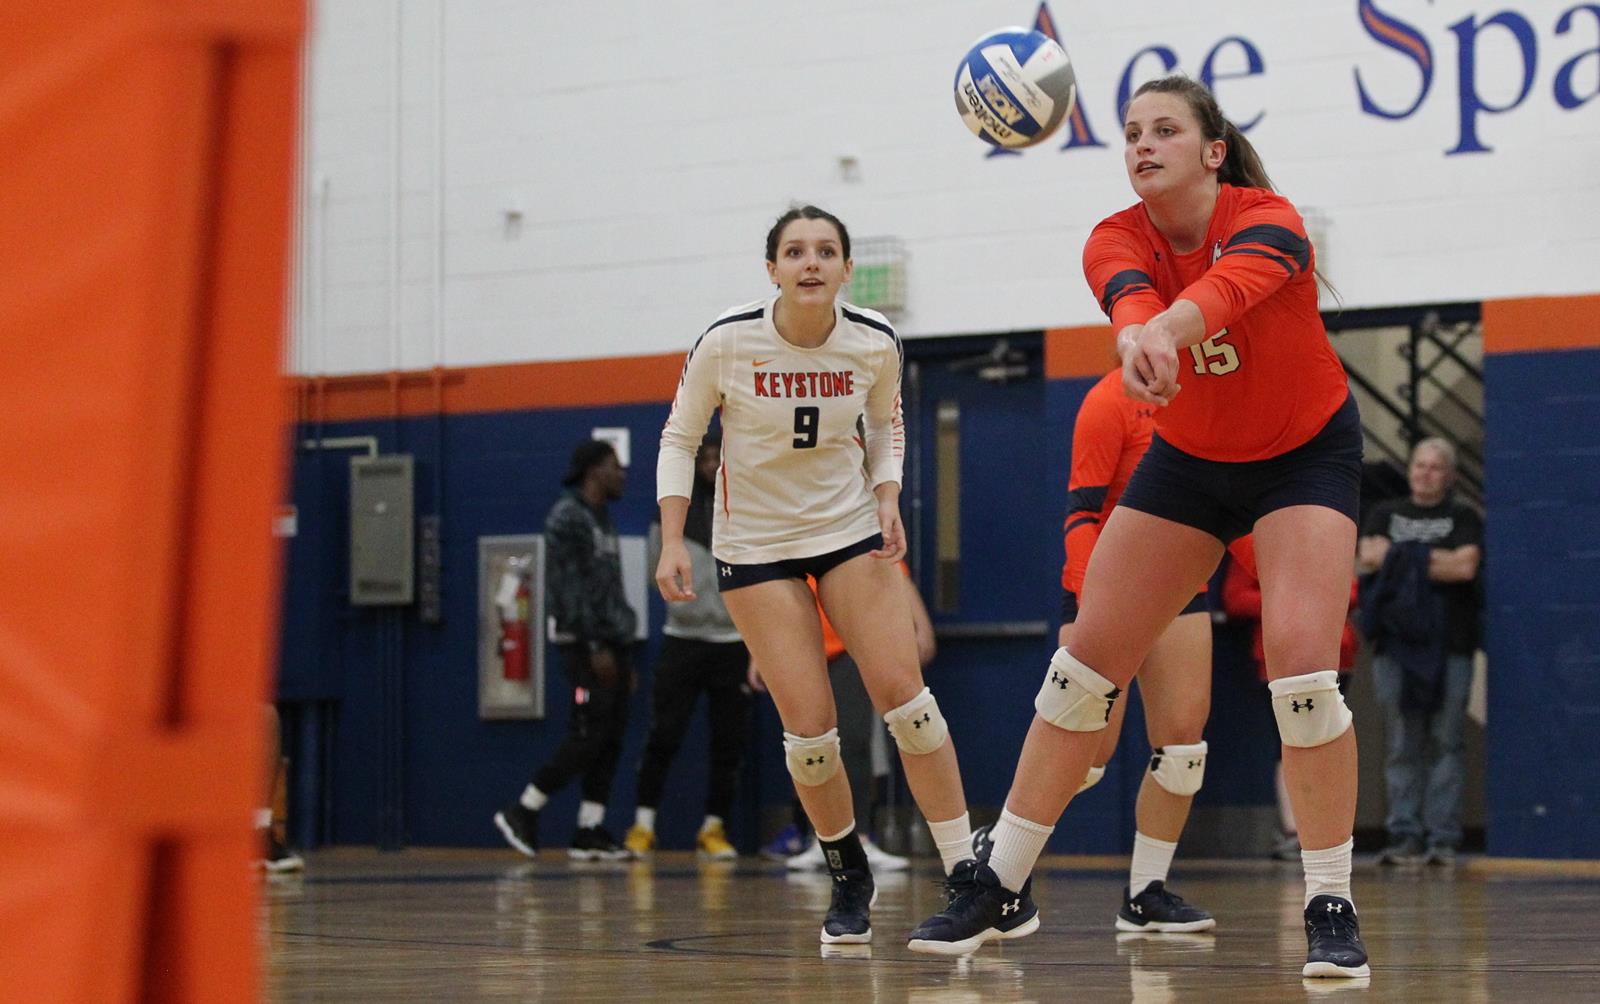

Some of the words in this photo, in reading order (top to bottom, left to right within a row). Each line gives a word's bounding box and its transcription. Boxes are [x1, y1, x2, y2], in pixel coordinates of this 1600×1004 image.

[963, 82, 1012, 138] molten
[1188, 327, 1241, 376] 15
[754, 370, 854, 398] KEYSTONE
[793, 406, 820, 449] 9
